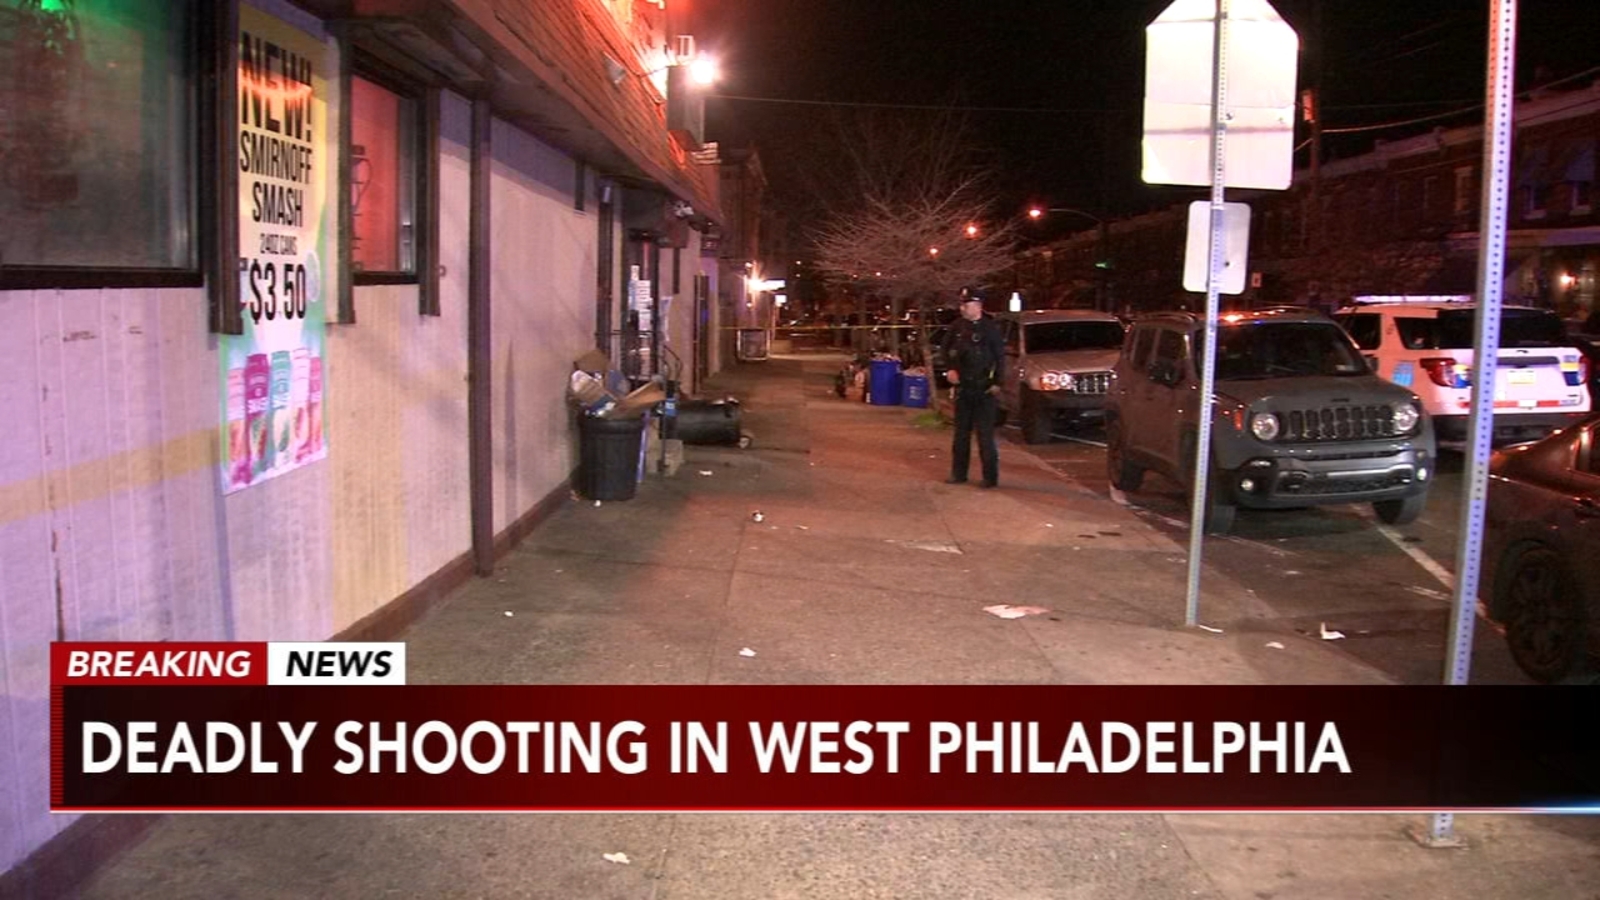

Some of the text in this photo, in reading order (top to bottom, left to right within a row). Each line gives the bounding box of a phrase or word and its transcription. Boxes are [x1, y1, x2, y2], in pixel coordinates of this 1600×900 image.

[241, 31, 312, 142] NEW!
[240, 130, 312, 184] SMIRNOFF
[252, 181, 303, 227] SMASH
